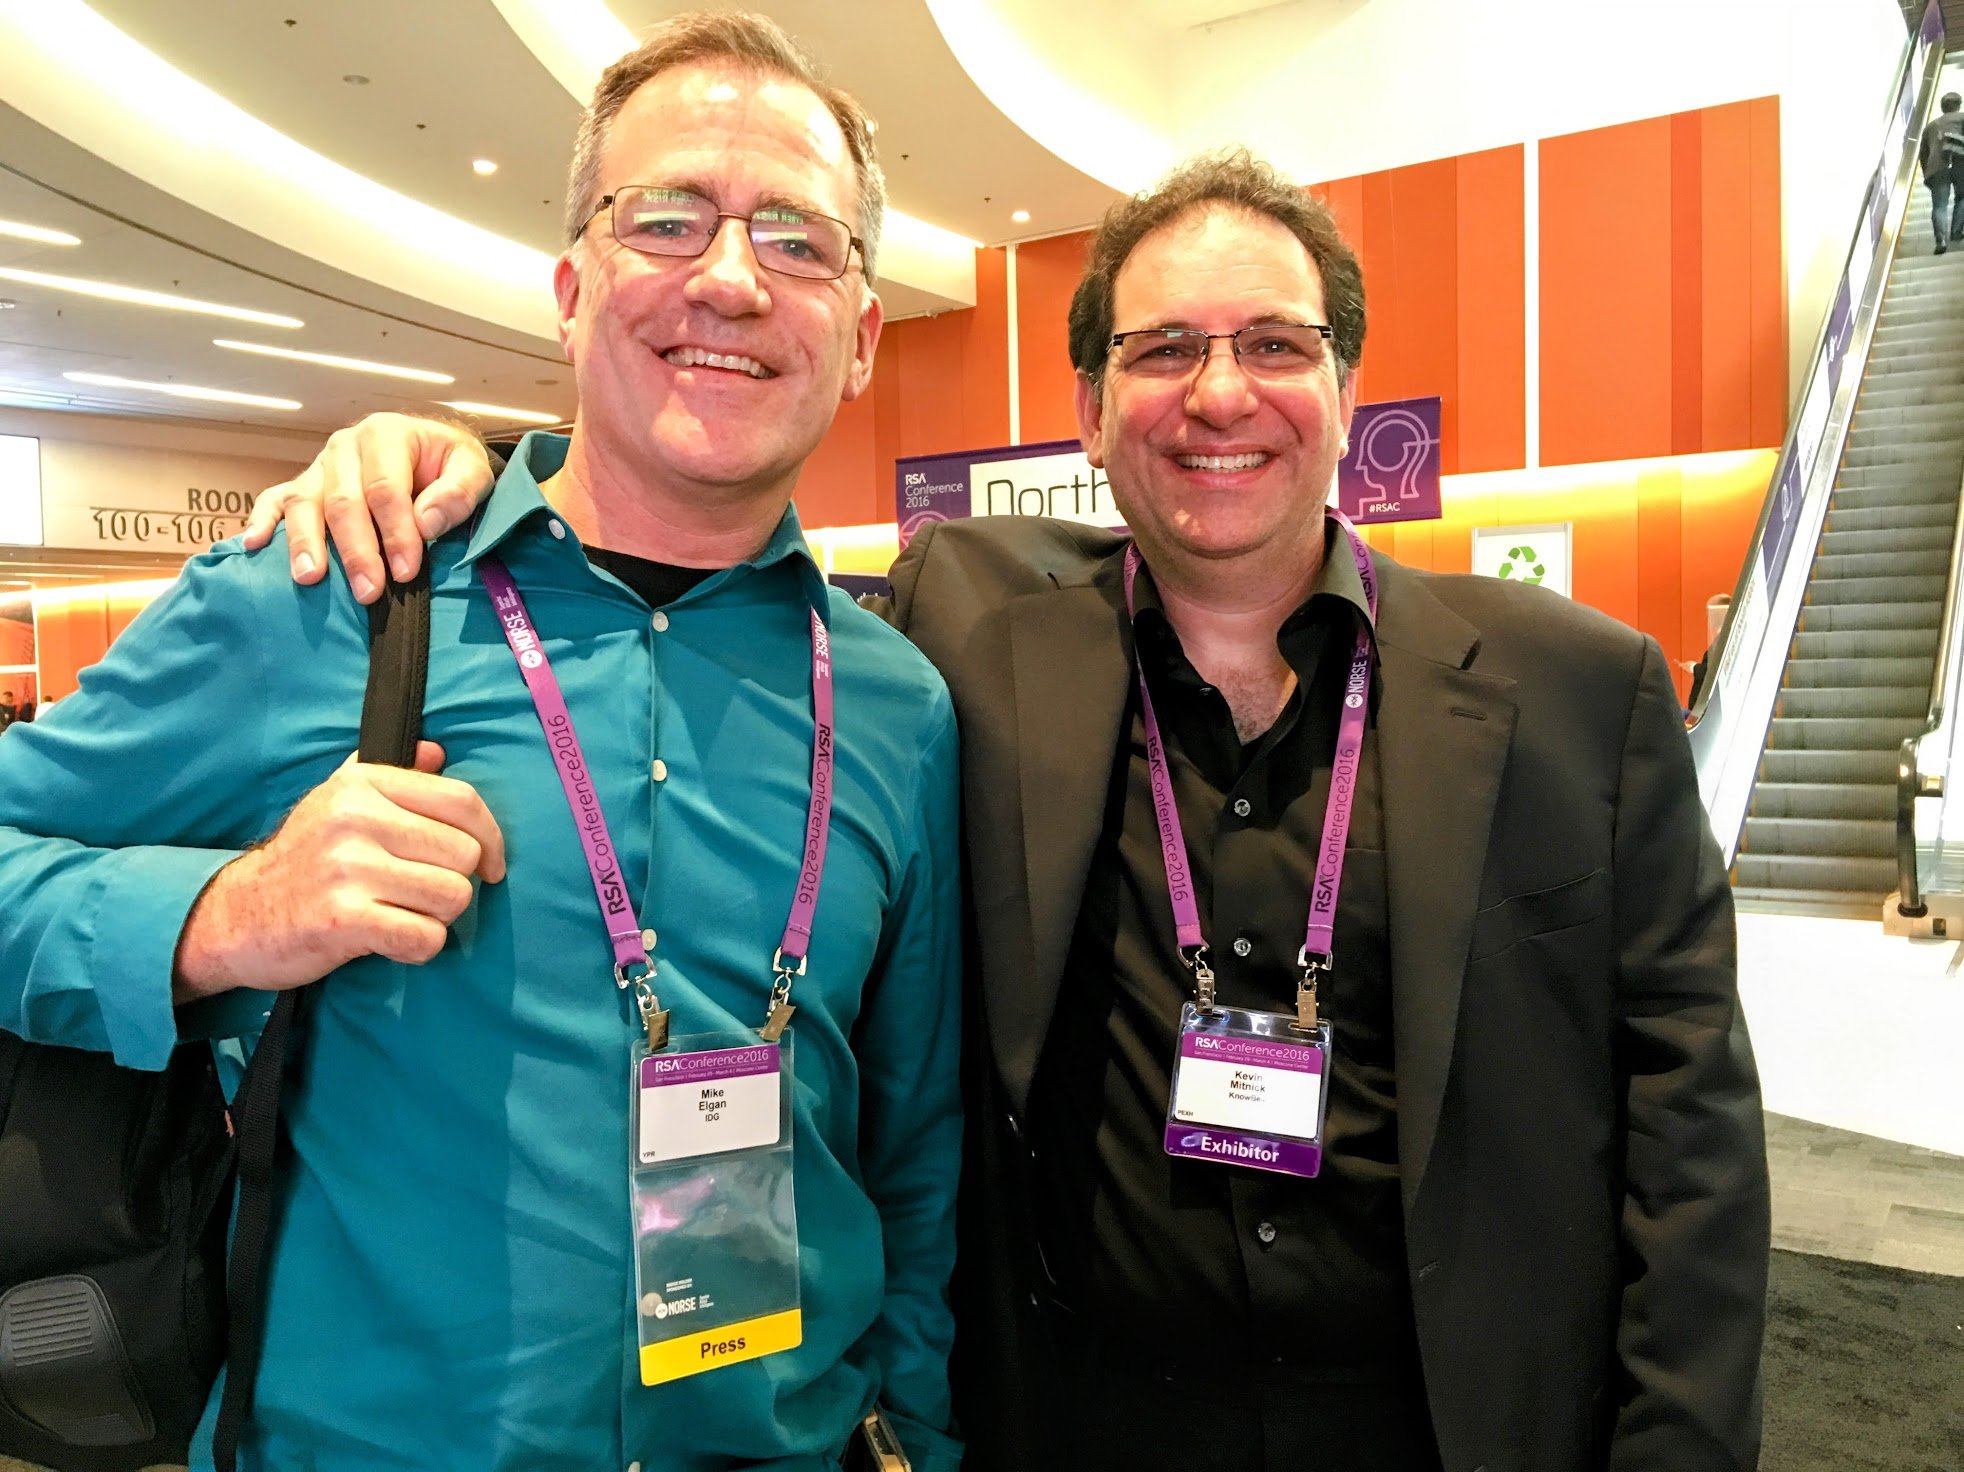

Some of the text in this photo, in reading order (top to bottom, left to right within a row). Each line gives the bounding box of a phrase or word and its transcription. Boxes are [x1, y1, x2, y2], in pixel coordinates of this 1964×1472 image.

[905, 473, 926, 485] RSA
[905, 482, 964, 497] Conference
[906, 497, 930, 509] 2016
[1369, 502, 1400, 513] #RSAC
[93, 509, 224, 544] 100-106
[504, 610, 535, 651] NORSE
[815, 619, 829, 659] NORSE
[1348, 660, 1367, 693] NORSE
[1235, 1070, 1263, 1082] Kevin
[1230, 1080, 1266, 1093] Mitnick
[701, 1089, 724, 1099] Mike
[699, 1100, 727, 1112] Elgan
[705, 1113, 720, 1122] IDG
[1201, 1136, 1280, 1163] Exhibitor
[667, 1296, 697, 1316] NORSE
[700, 1337, 746, 1359] Press
